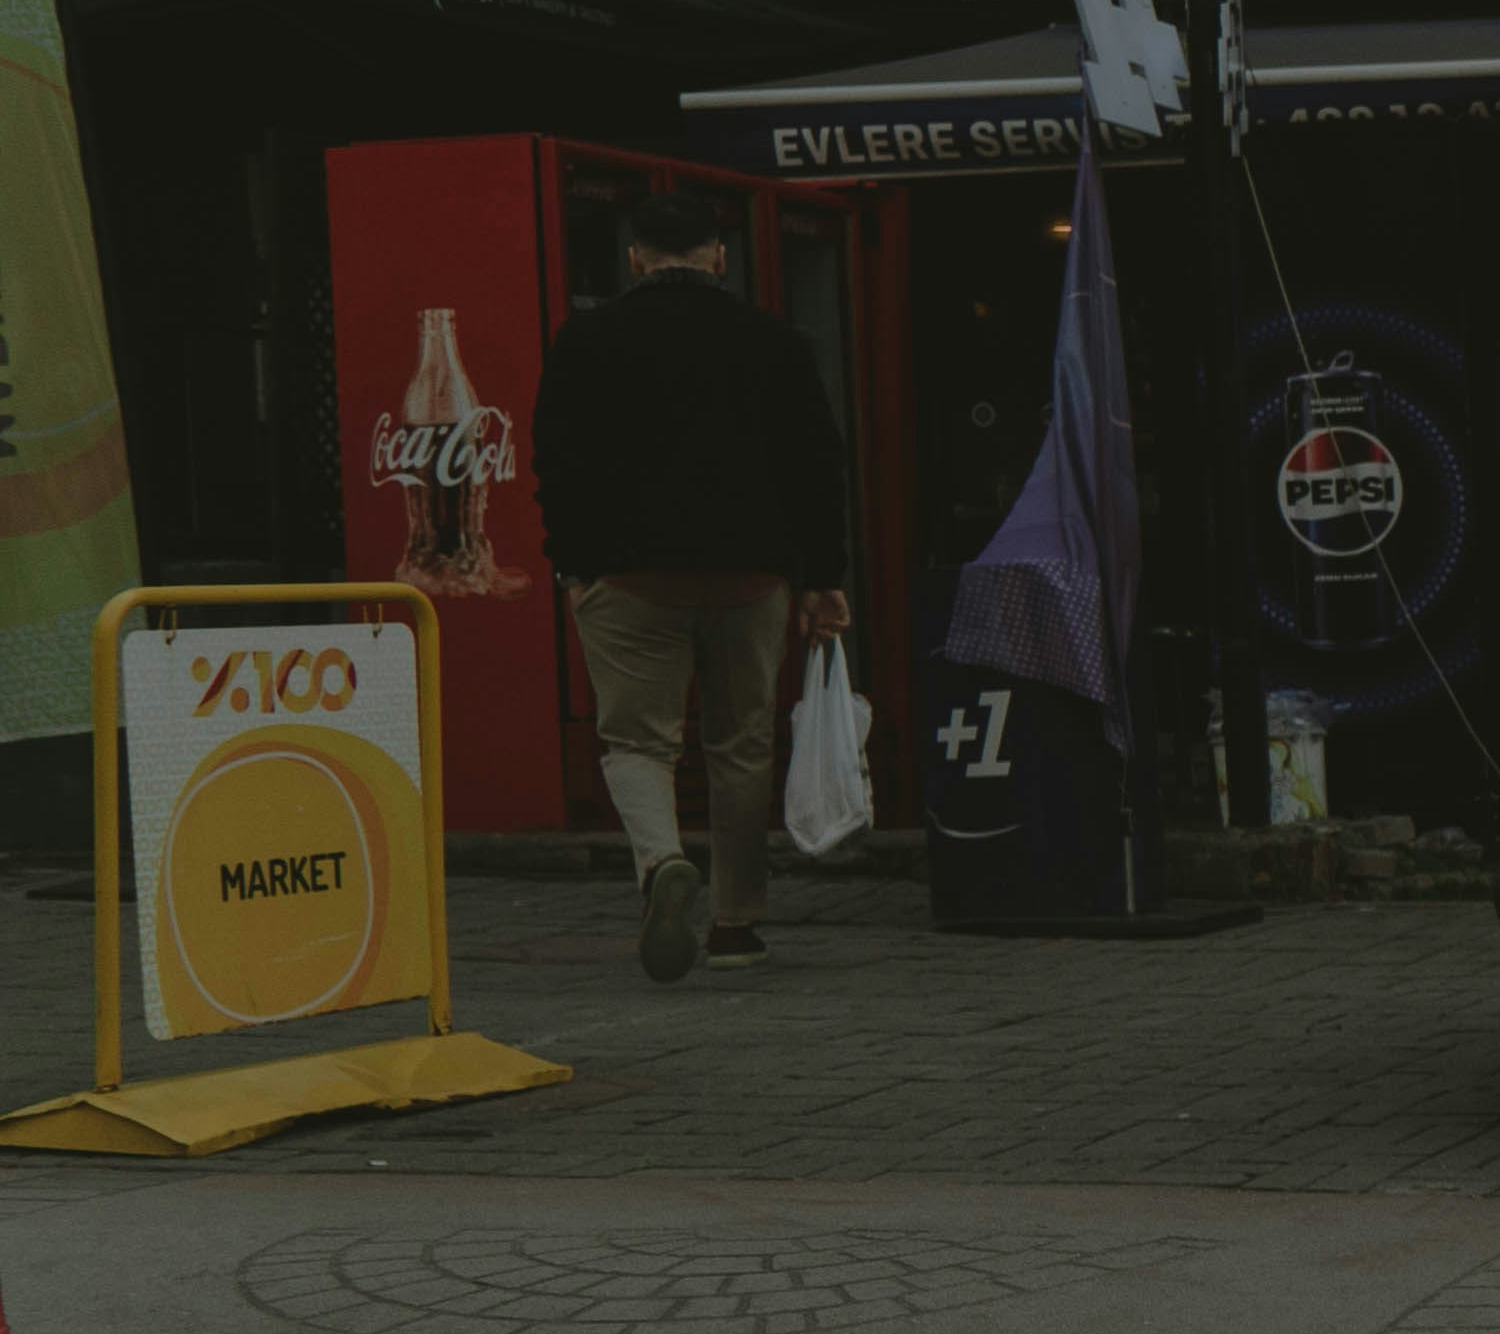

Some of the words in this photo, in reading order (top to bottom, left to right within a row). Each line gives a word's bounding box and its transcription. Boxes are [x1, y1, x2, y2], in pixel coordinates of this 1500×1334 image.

[772, 121, 961, 168] EVLERE
[369, 405, 517, 488] Coca-Cola
[1285, 476, 1395, 506] PEPSI
[936, 689, 1012, 779] +1
[220, 851, 347, 903] MARKET
